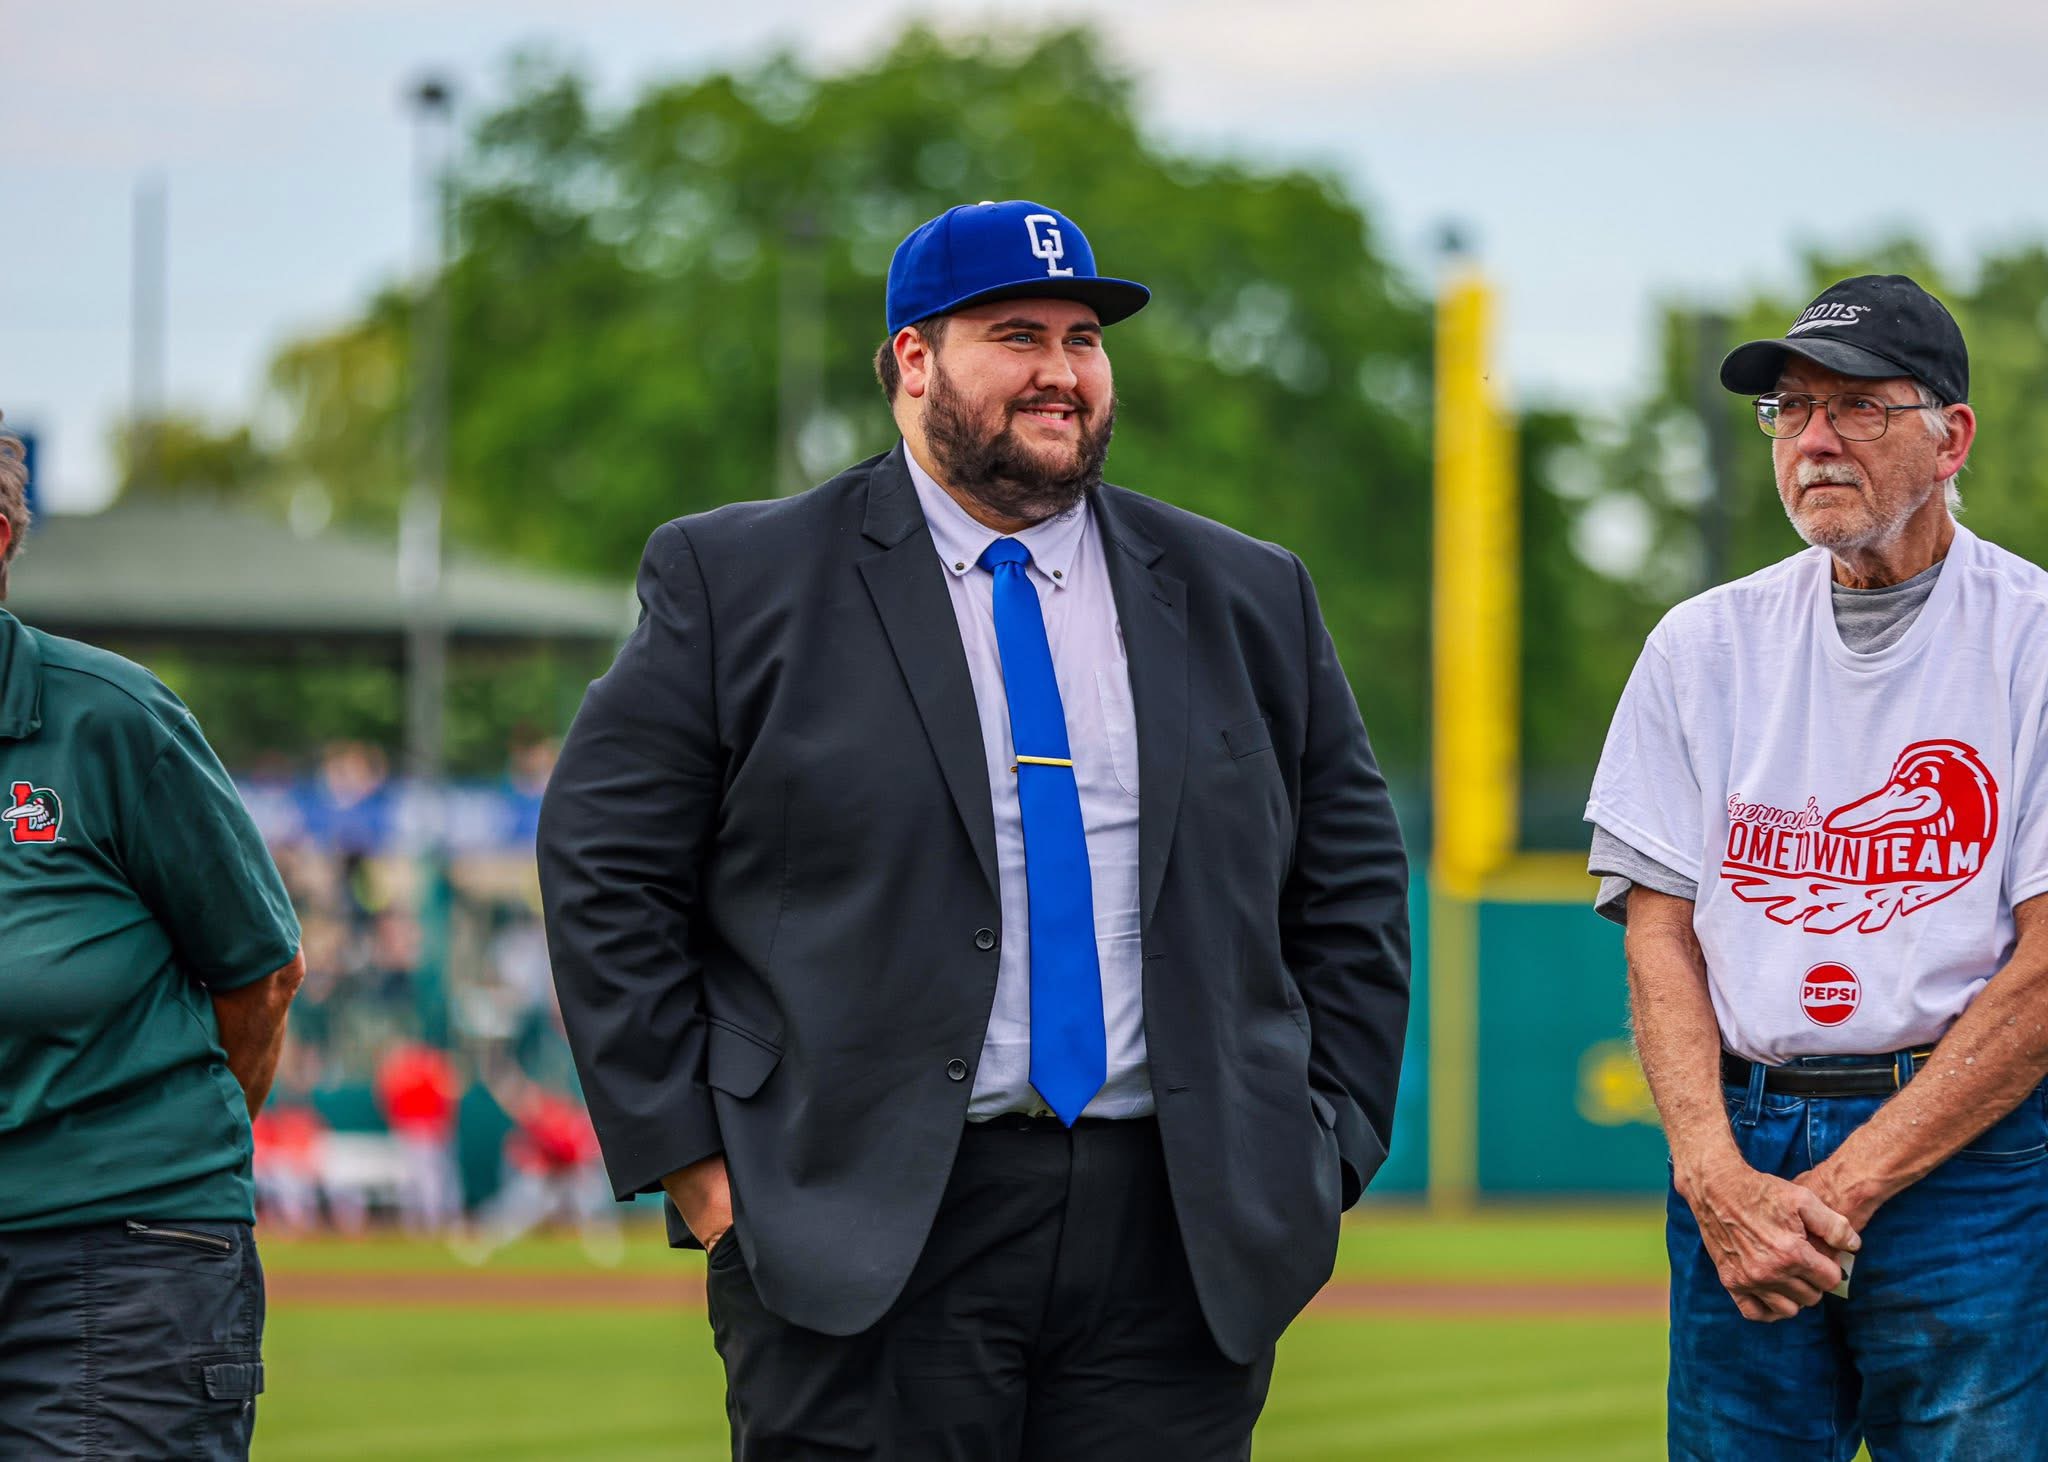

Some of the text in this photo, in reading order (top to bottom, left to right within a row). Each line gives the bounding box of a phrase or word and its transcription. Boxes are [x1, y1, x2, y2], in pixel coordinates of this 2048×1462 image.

[1024, 214, 1074, 278] GL
[1728, 793, 1824, 834] Everyon's
[1727, 821, 1981, 878] OMETOWN TEAM
[1804, 986, 1857, 1002] PEPSI
